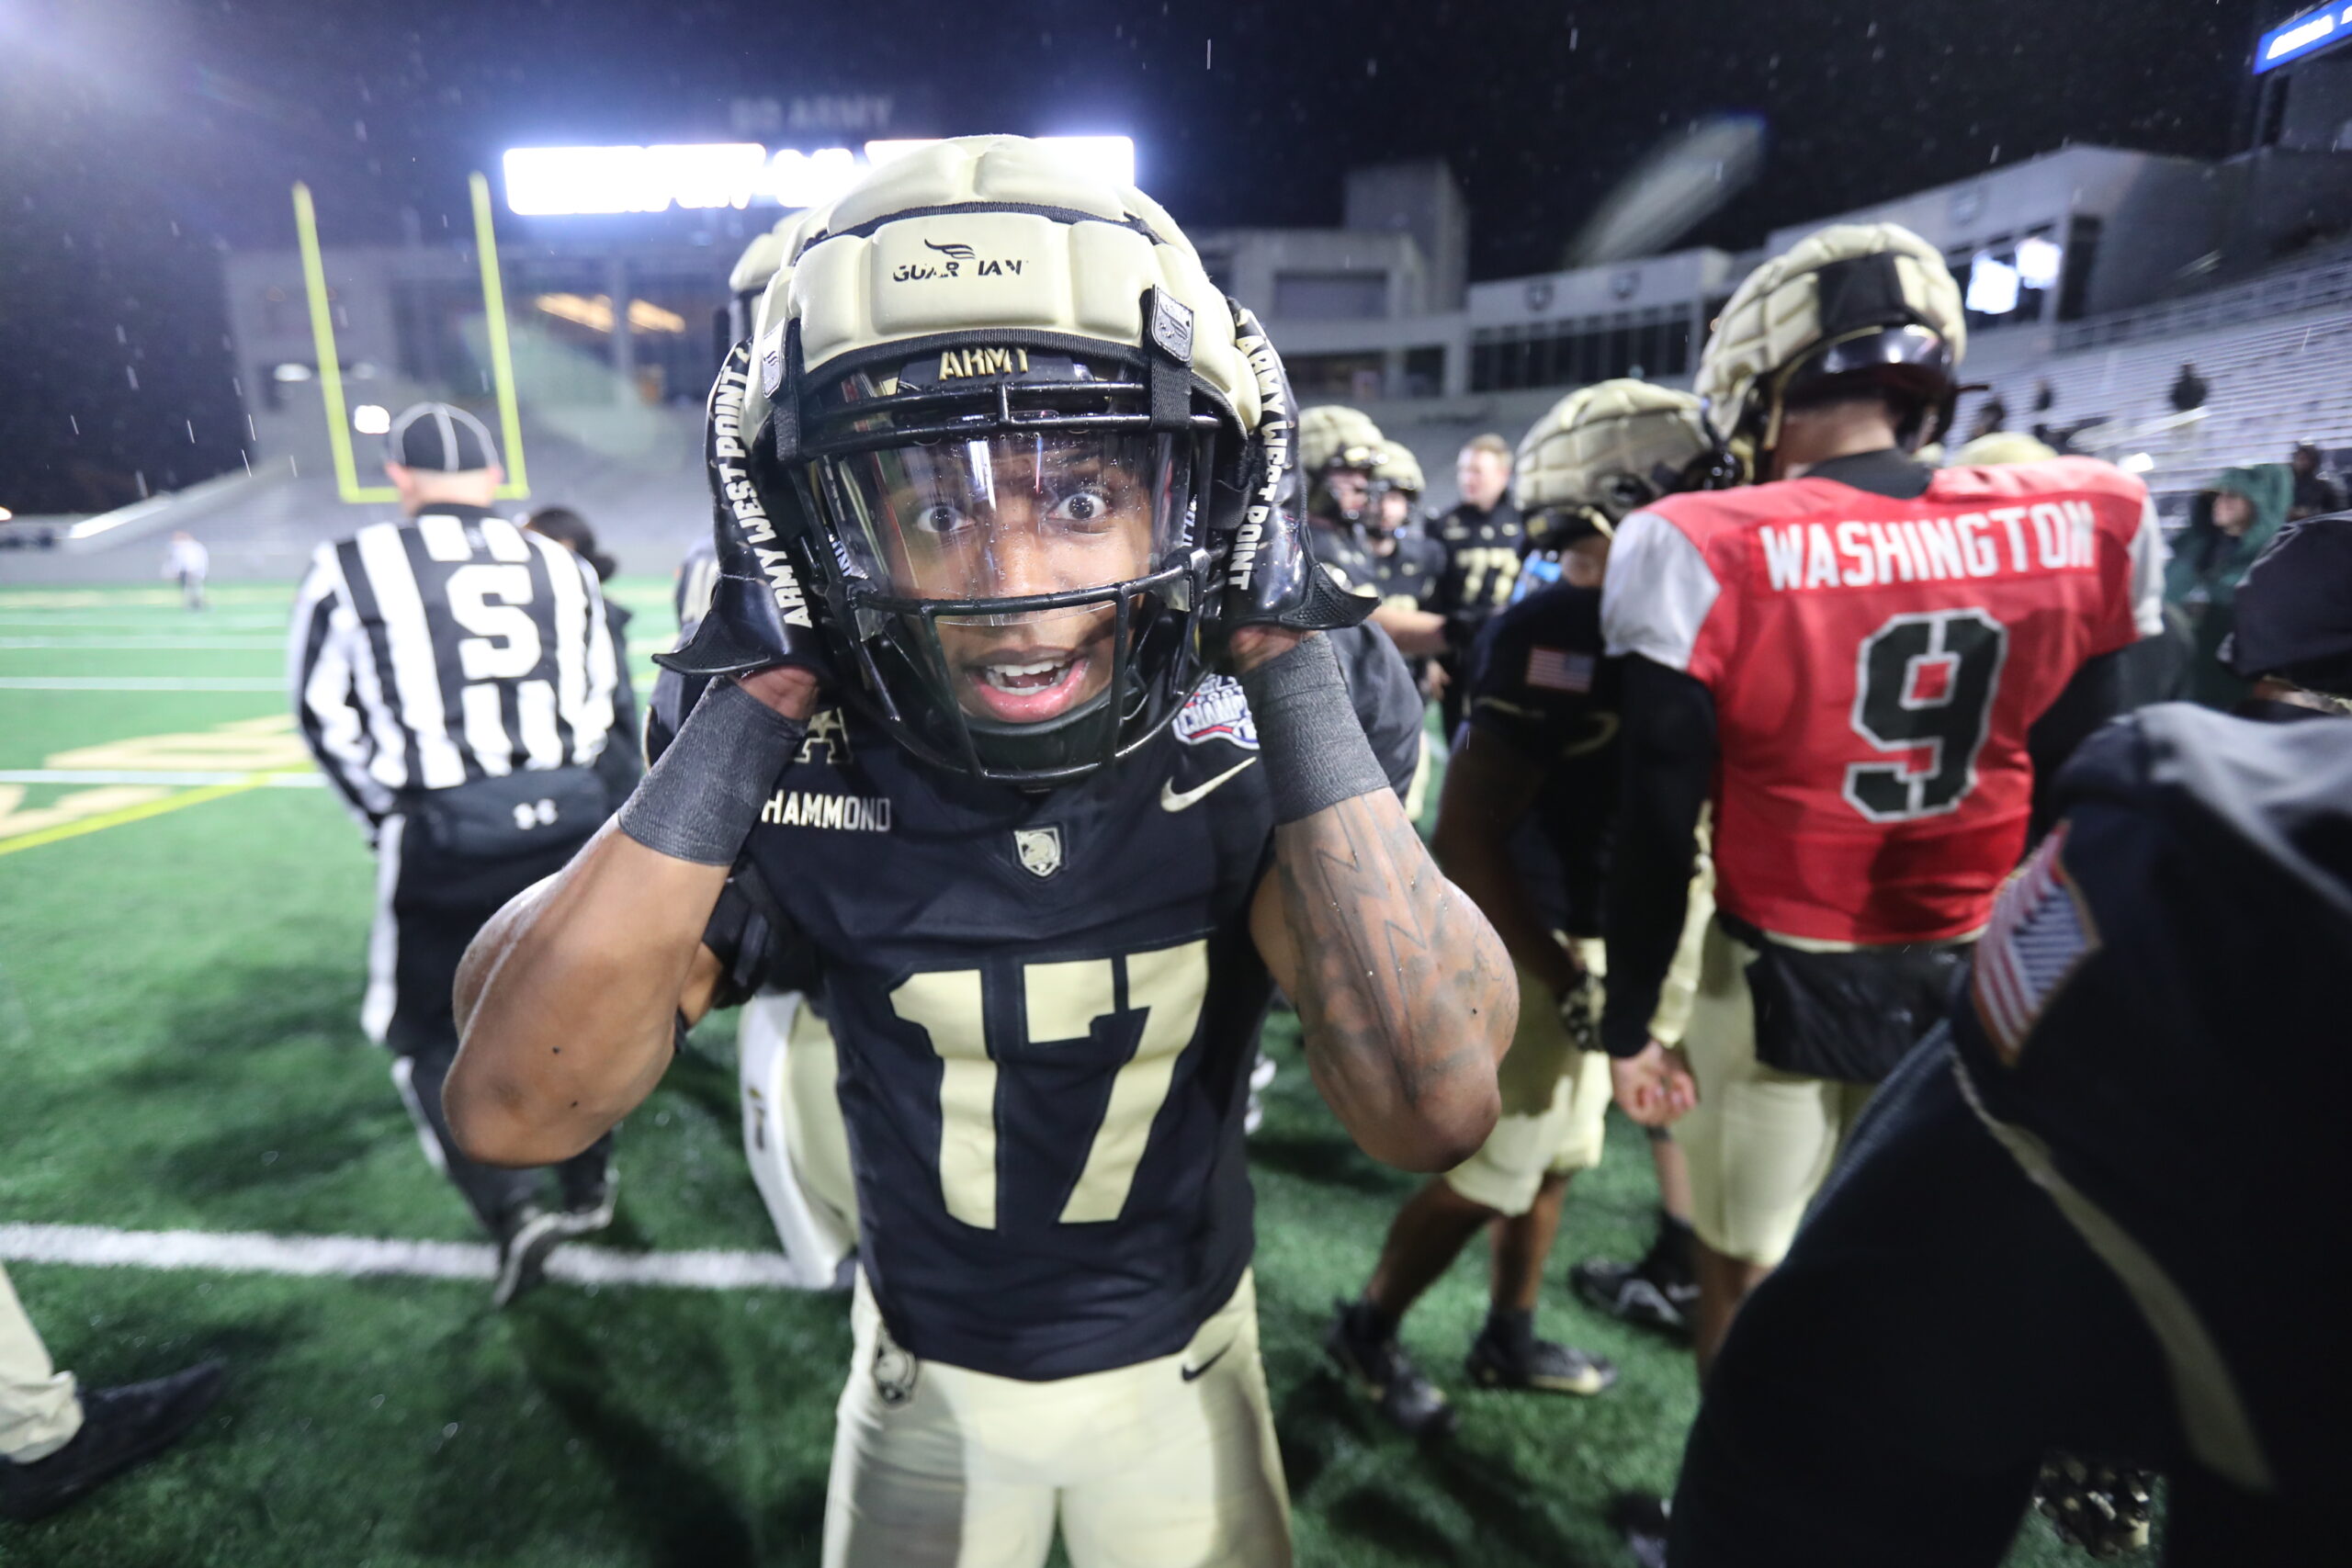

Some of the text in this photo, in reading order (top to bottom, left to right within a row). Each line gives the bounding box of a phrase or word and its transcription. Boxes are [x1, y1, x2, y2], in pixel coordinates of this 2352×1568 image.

[1237, 335, 1285, 415] ARMY
[714, 366, 812, 628] ARMY WEST POINT
[1758, 502, 2096, 590] WASHINGTON
[1228, 505, 1269, 591] POINT
[446, 565, 542, 680] S
[1843, 607, 2007, 821] 9
[761, 789, 891, 832] HAMMOND
[889, 940, 1208, 1229] 17
